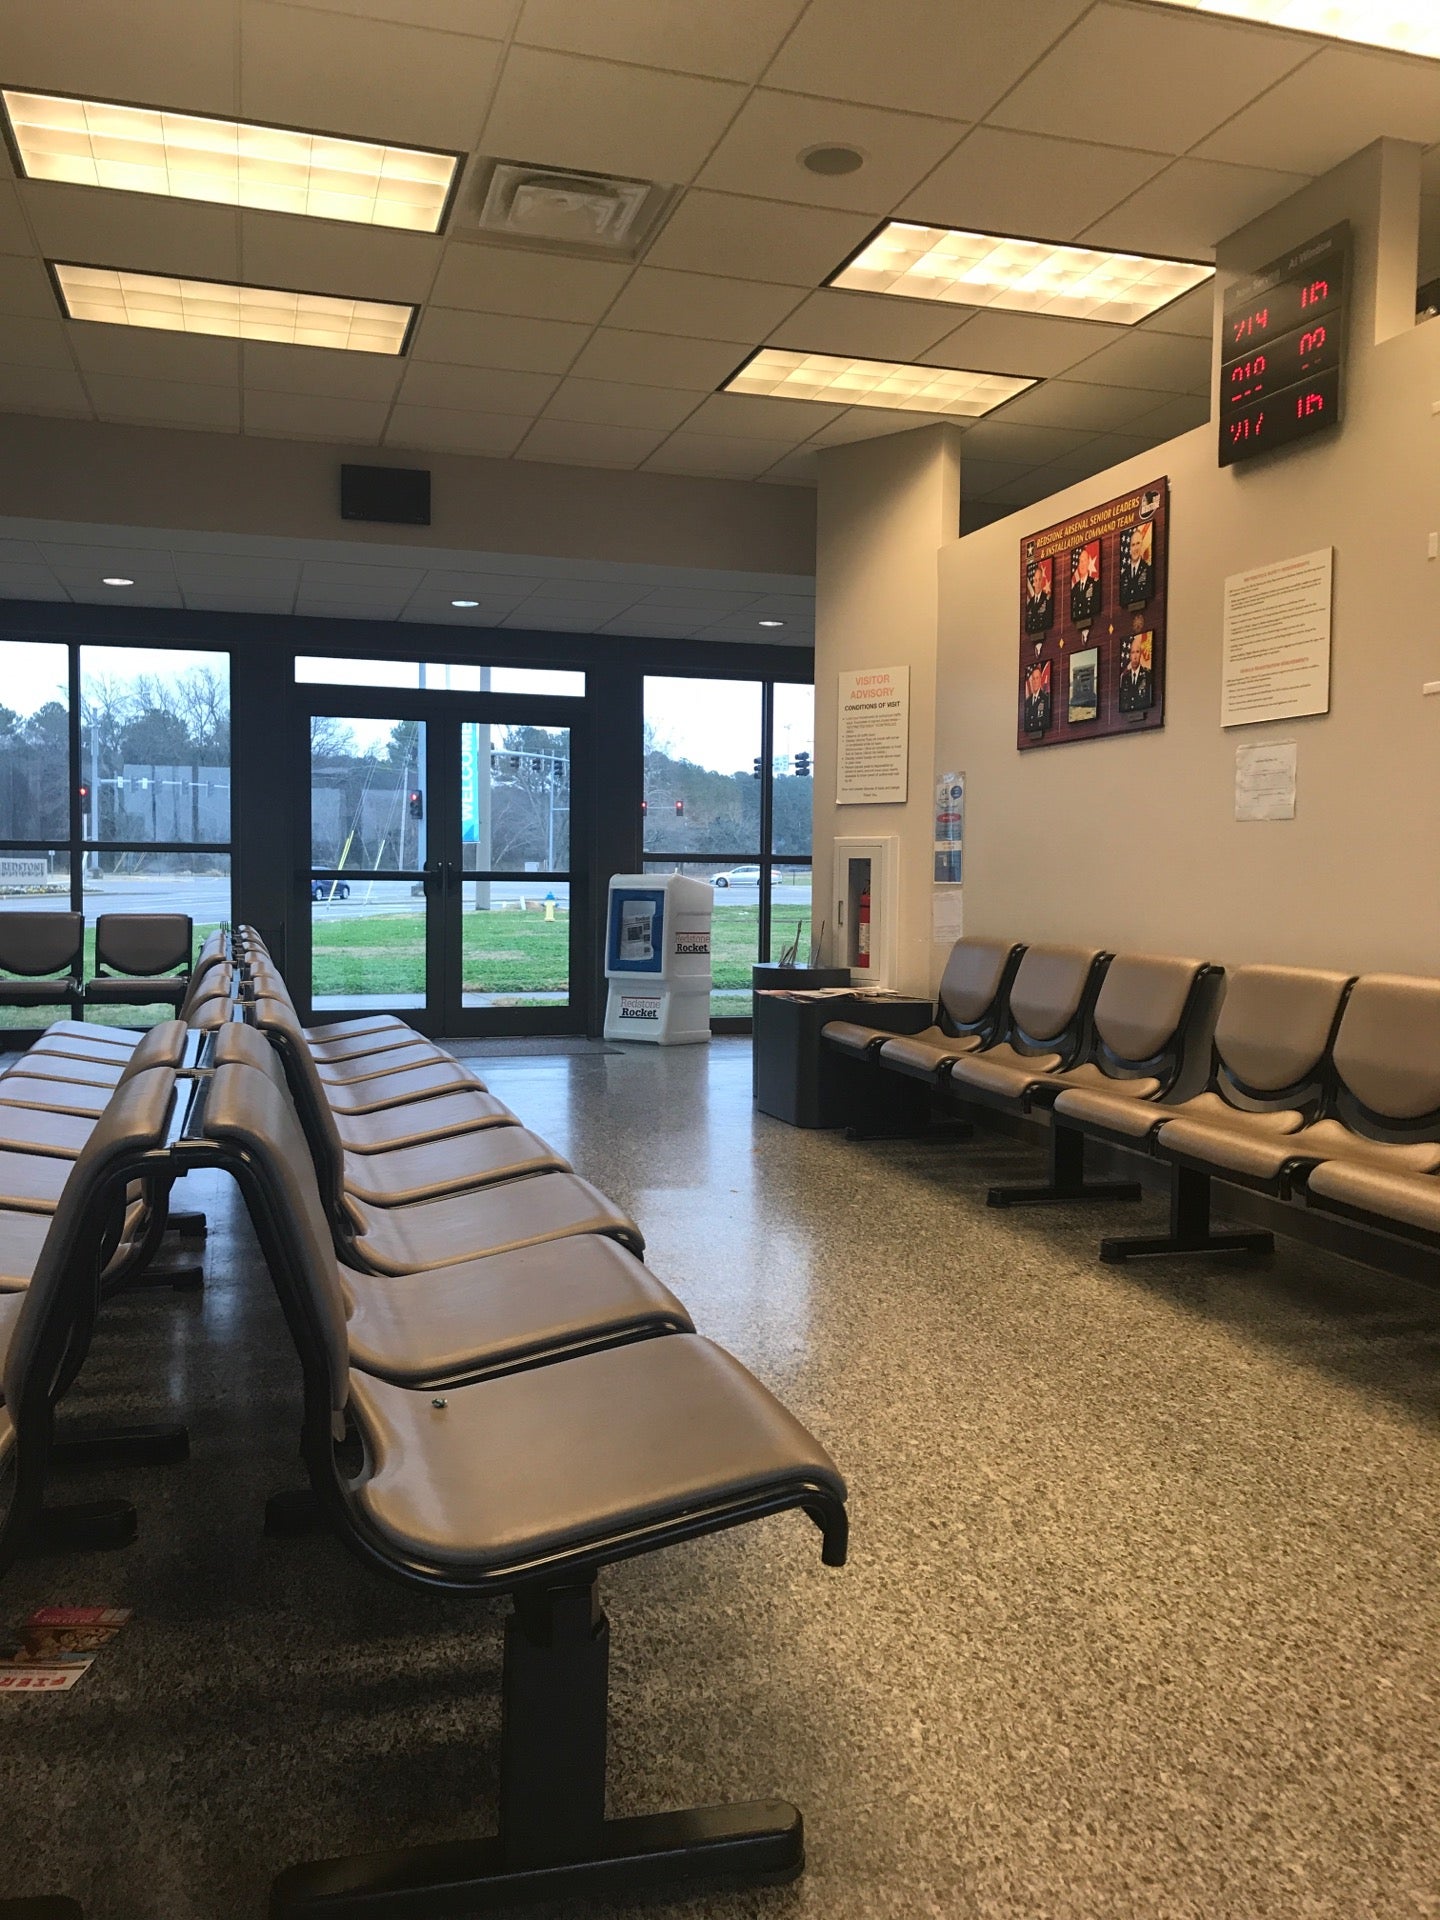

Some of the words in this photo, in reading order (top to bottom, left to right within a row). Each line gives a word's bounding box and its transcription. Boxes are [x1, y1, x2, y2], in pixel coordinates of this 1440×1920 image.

[1036, 529, 1063, 548] REDSTONE
[1064, 518, 1089, 537] ARSENAL
[1089, 510, 1111, 526] SENIOR
[1112, 496, 1140, 517] LEADERS
[1046, 535, 1084, 558] INSTALLATION
[1084, 520, 1116, 541] COMMAND
[1116, 513, 1135, 528] TEAM
[855, 673, 890, 686] VISITOR
[850, 687, 895, 699] ADVISORY
[844, 703, 878, 711] CONDITIONS
[887, 700, 900, 708] VISIT
[462, 722, 474, 821] WELCOME
[676, 934, 710, 943] Redstone
[677, 943, 708, 952] Rocket
[620, 998, 661, 1009] Redstone
[622, 1007, 657, 1017] Rocket
